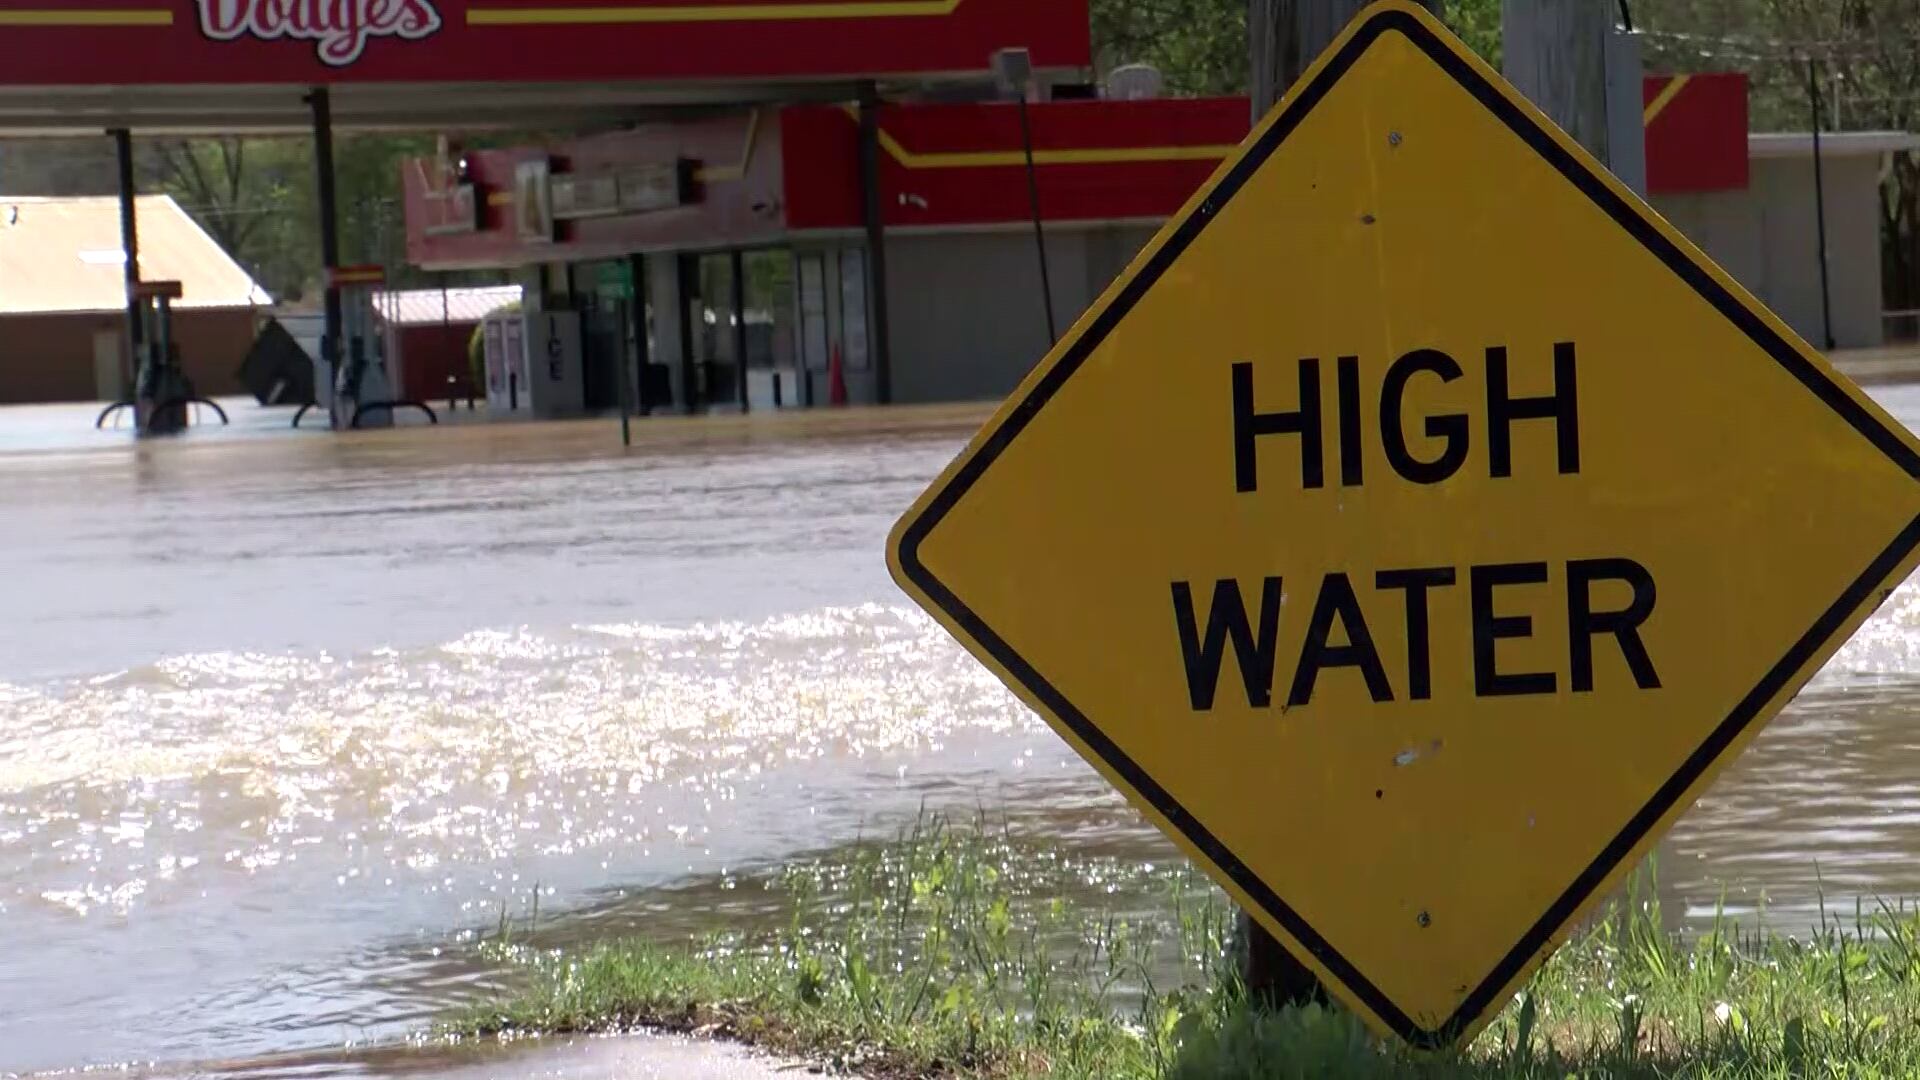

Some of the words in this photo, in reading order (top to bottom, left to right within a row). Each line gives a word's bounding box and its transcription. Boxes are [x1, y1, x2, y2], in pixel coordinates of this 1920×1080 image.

[548, 315, 563, 381] ICE
[1231, 341, 1581, 493] HIGH
[1170, 557, 1663, 712] WATER
